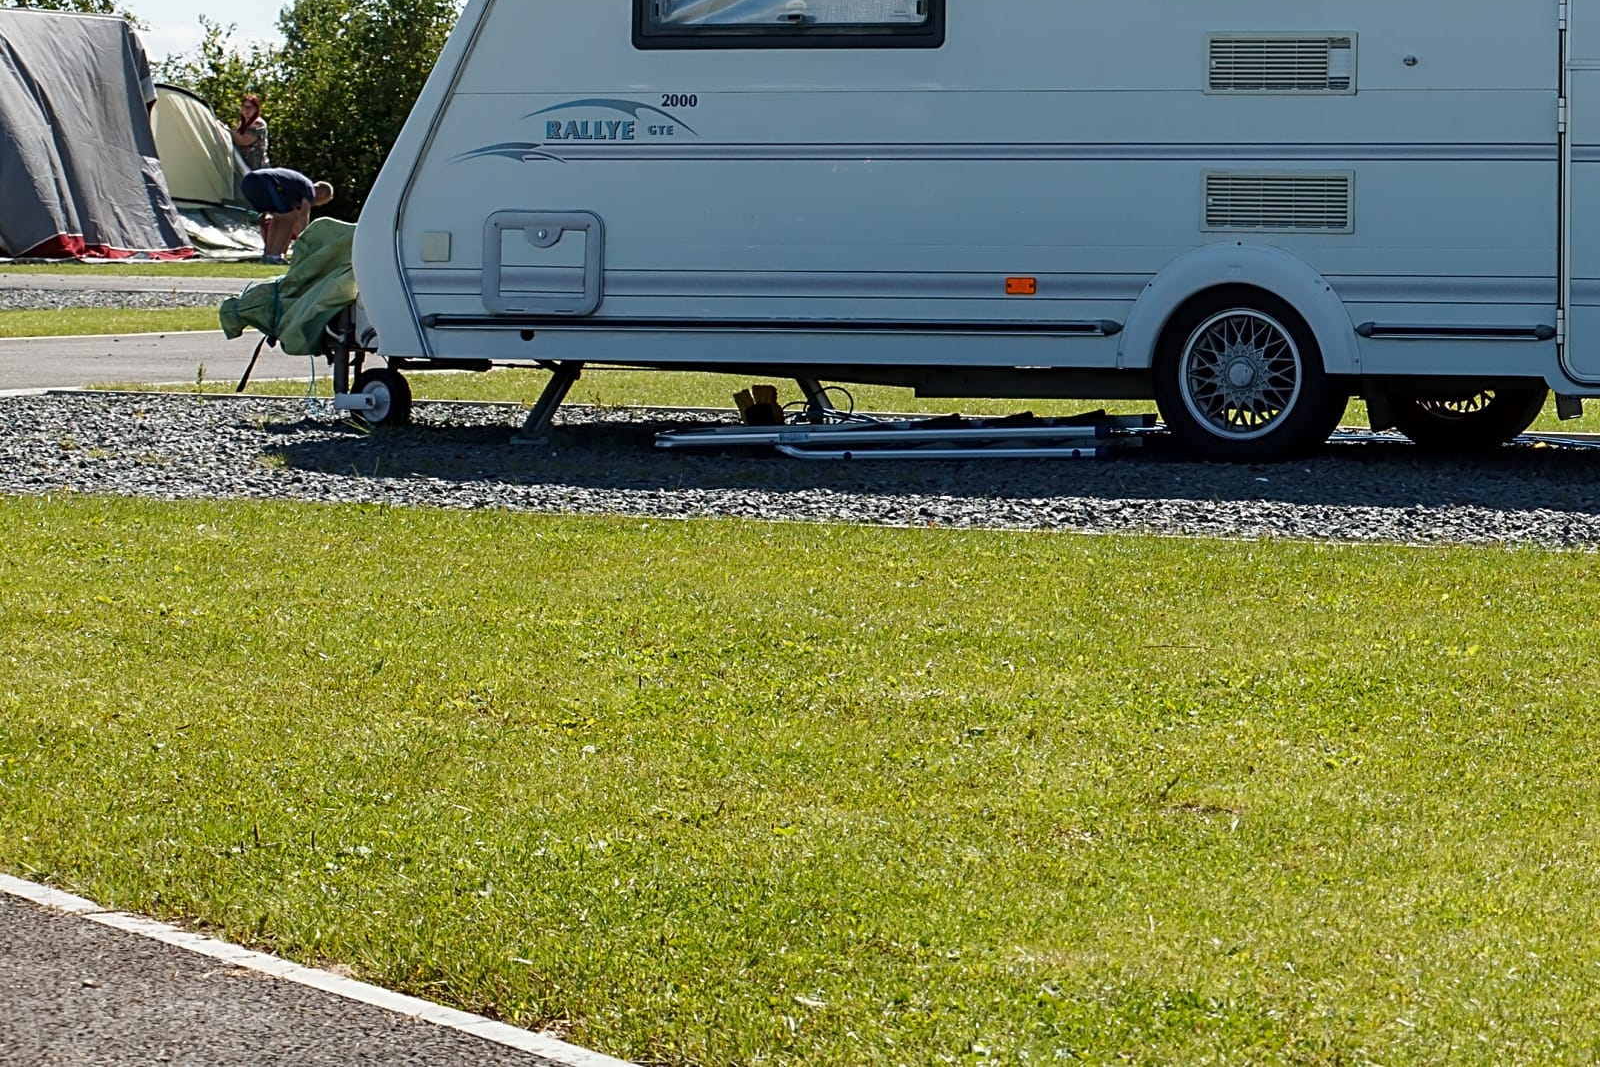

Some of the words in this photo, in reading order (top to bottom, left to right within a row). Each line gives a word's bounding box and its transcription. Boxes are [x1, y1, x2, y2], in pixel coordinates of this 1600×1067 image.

[661, 94, 698, 107] 2000
[546, 120, 635, 140] RALLYE
[648, 125, 674, 136] GTE
